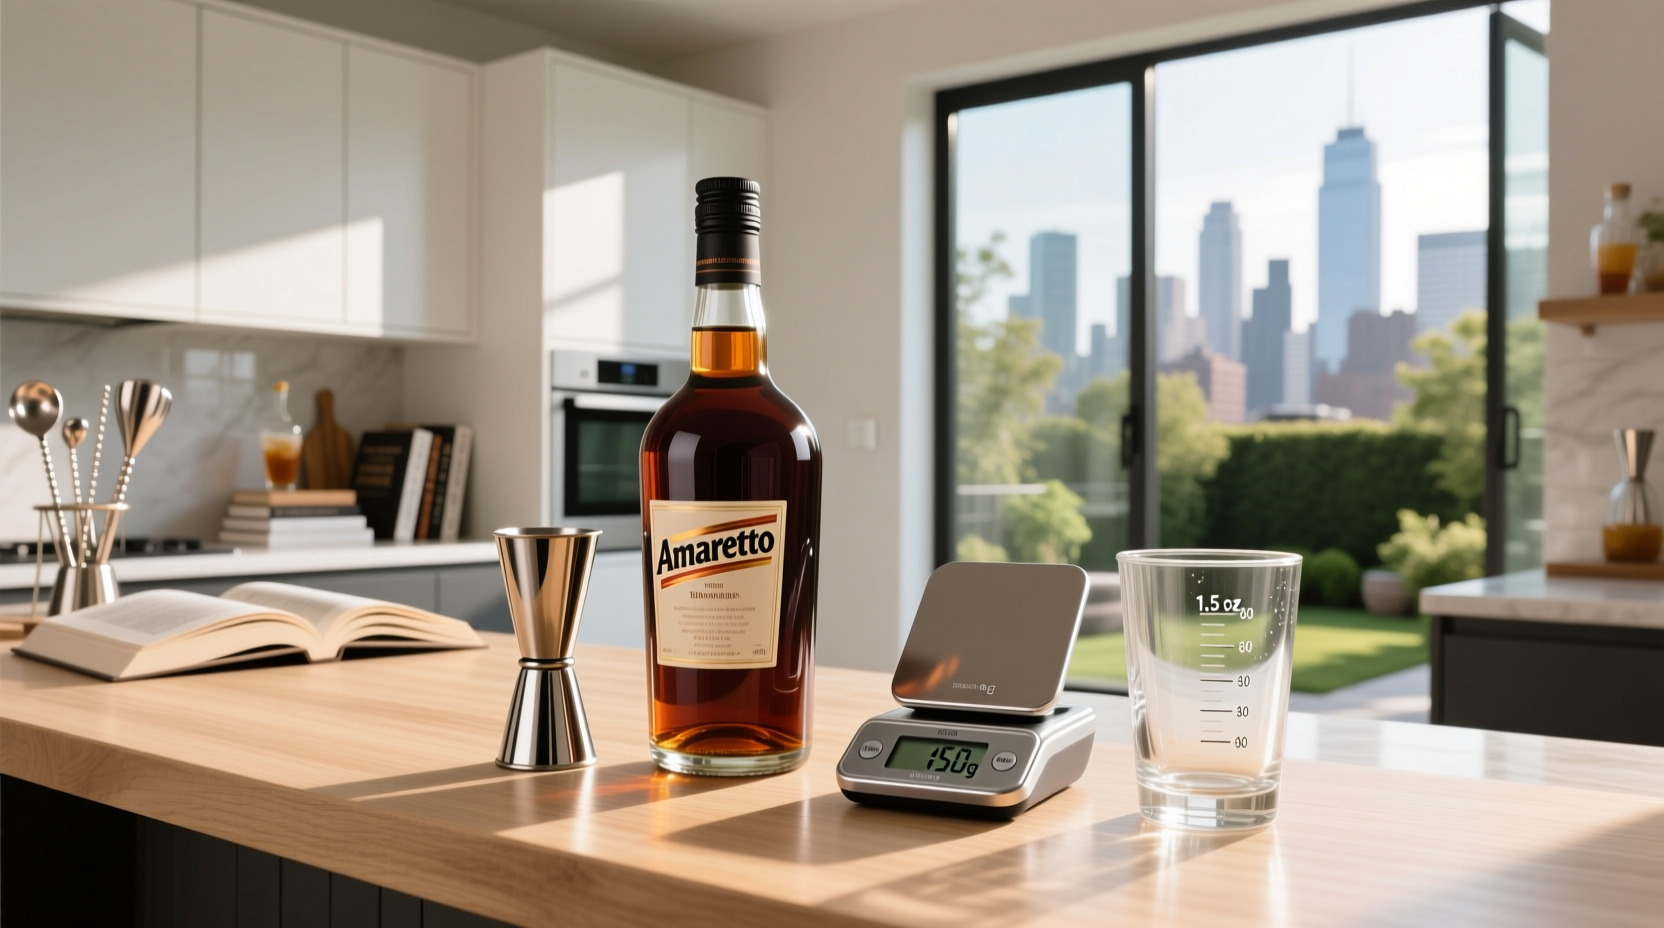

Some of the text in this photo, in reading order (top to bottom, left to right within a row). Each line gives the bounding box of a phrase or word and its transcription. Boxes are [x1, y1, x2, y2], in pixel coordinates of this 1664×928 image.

[656, 529, 774, 575] Amaretto
[1196, 594, 1242, 612] 1.5 oz
[1236, 705, 1249, 718] 30
